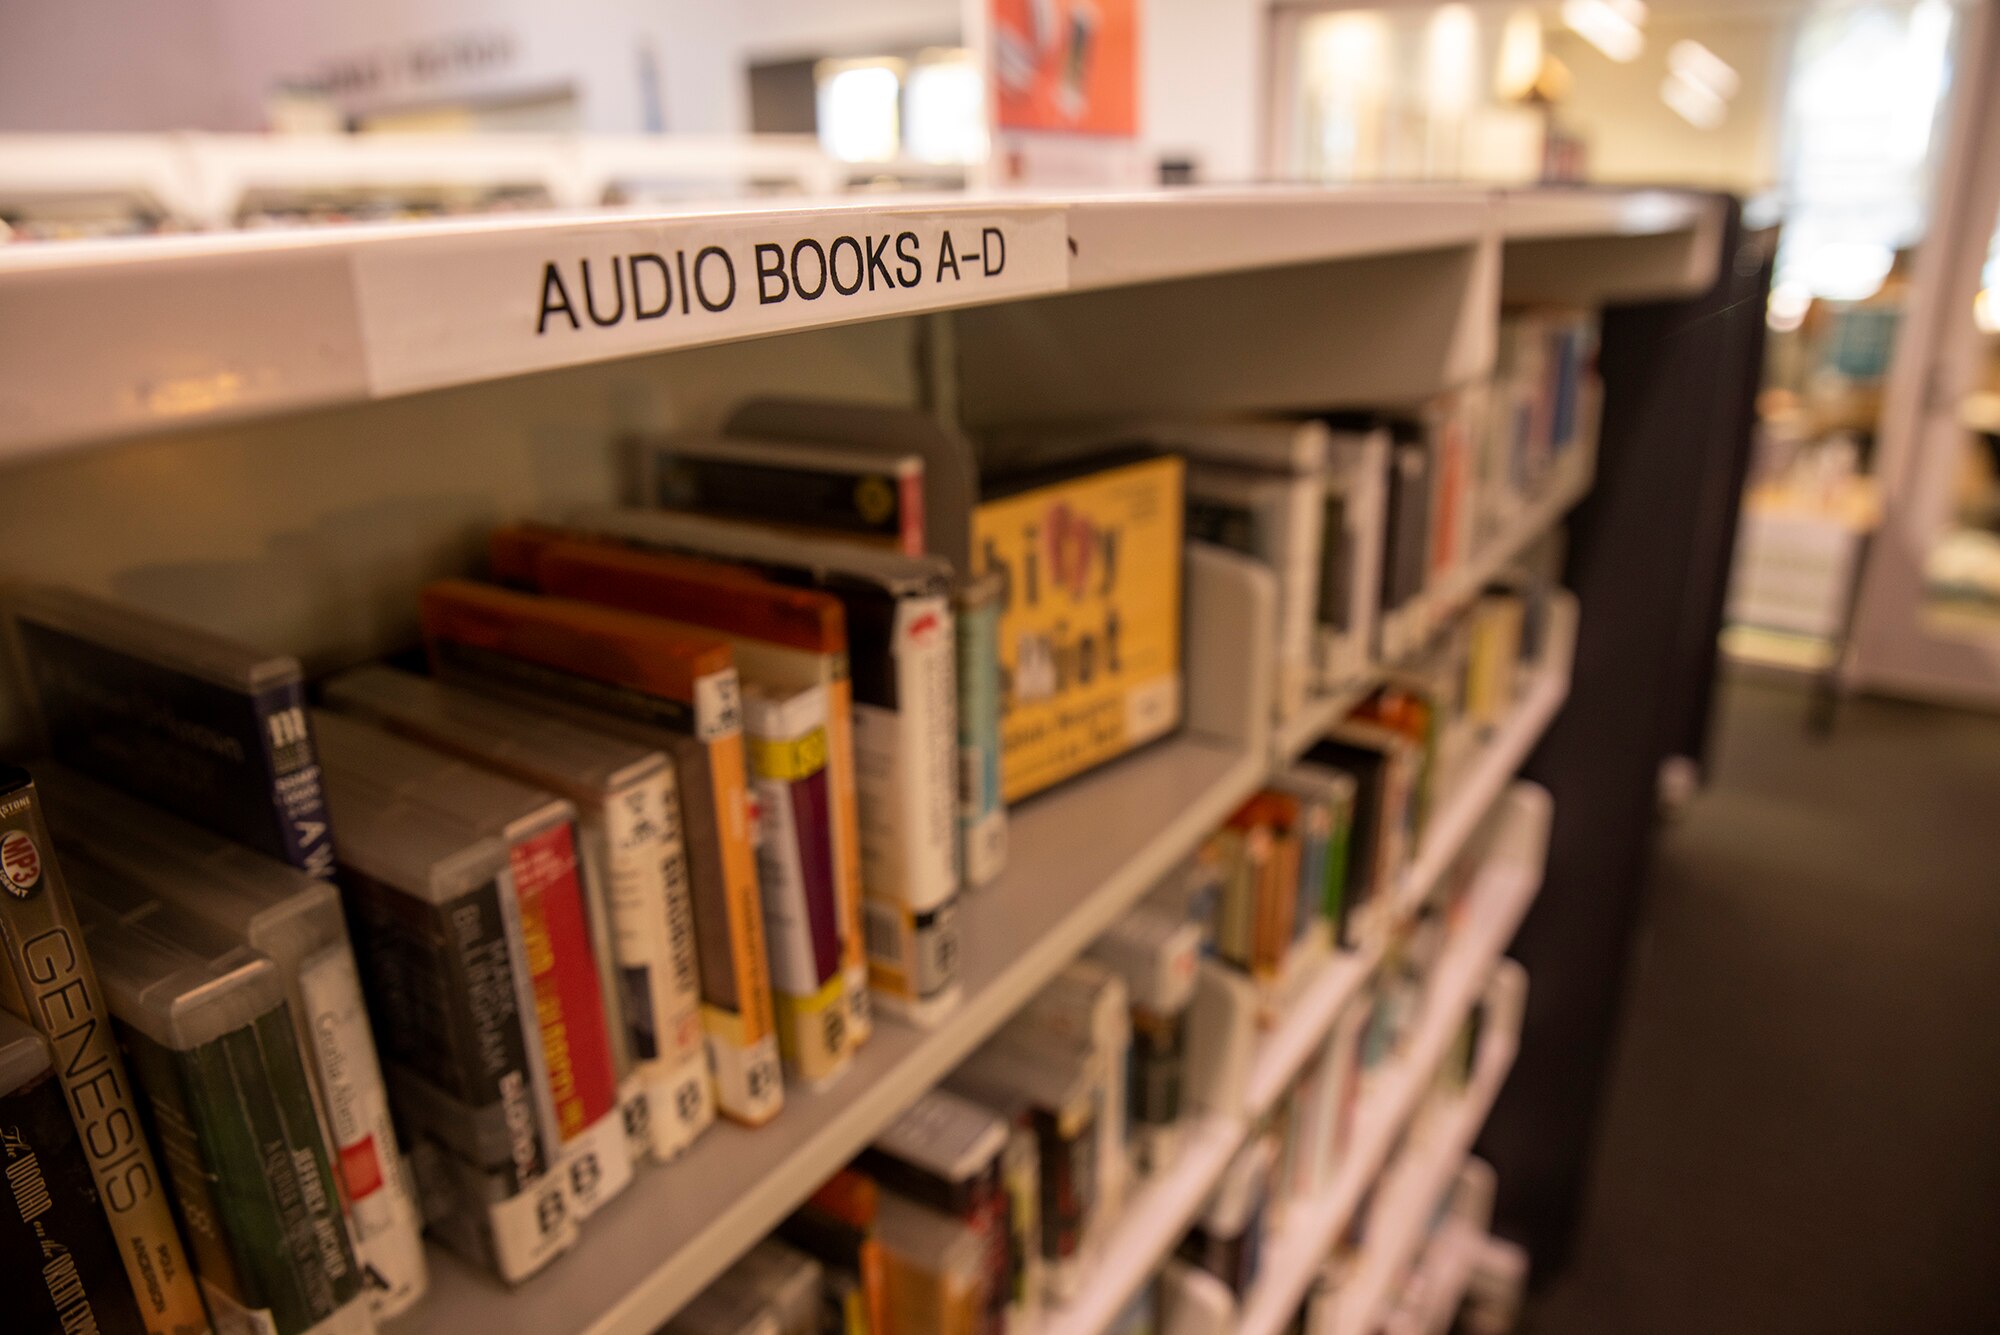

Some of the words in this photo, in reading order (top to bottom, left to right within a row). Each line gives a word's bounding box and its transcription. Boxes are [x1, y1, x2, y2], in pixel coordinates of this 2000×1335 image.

[536, 245, 735, 335] AUDIO
[755, 231, 921, 305] BOOKS
[4, 836, 39, 883] MP3
[22, 928, 153, 1214] GENESIS
[0, 1125, 32, 1158] The
[5, 1152, 53, 1224] WOMAN
[570, 1153, 601, 1197] B
[33, 1221, 46, 1238] on
[536, 1189, 566, 1235] B
[40, 1239, 68, 1258] the
[42, 1252, 86, 1312] ORIENT
